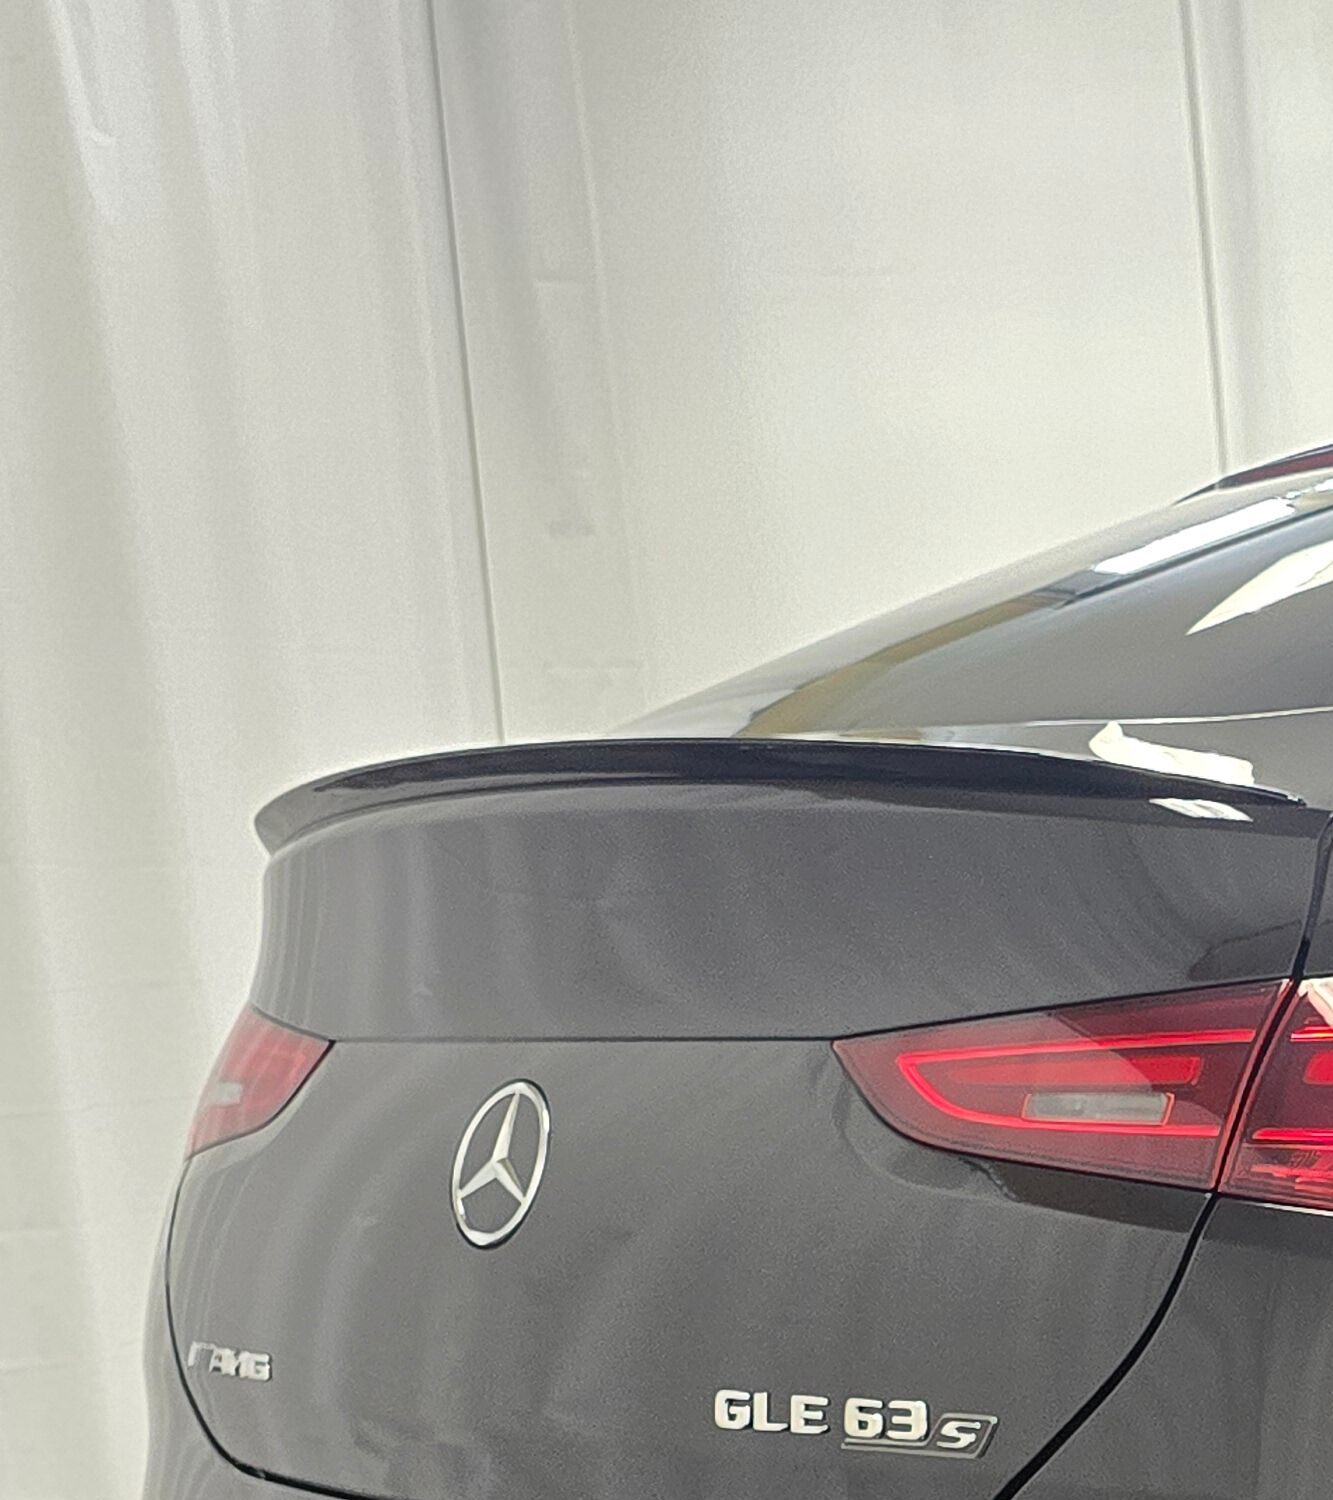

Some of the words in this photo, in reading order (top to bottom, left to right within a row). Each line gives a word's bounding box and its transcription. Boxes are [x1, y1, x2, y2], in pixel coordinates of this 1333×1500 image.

[714, 1389, 829, 1435] GLE
[844, 1397, 928, 1440] 63
[936, 1420, 982, 1449] S
